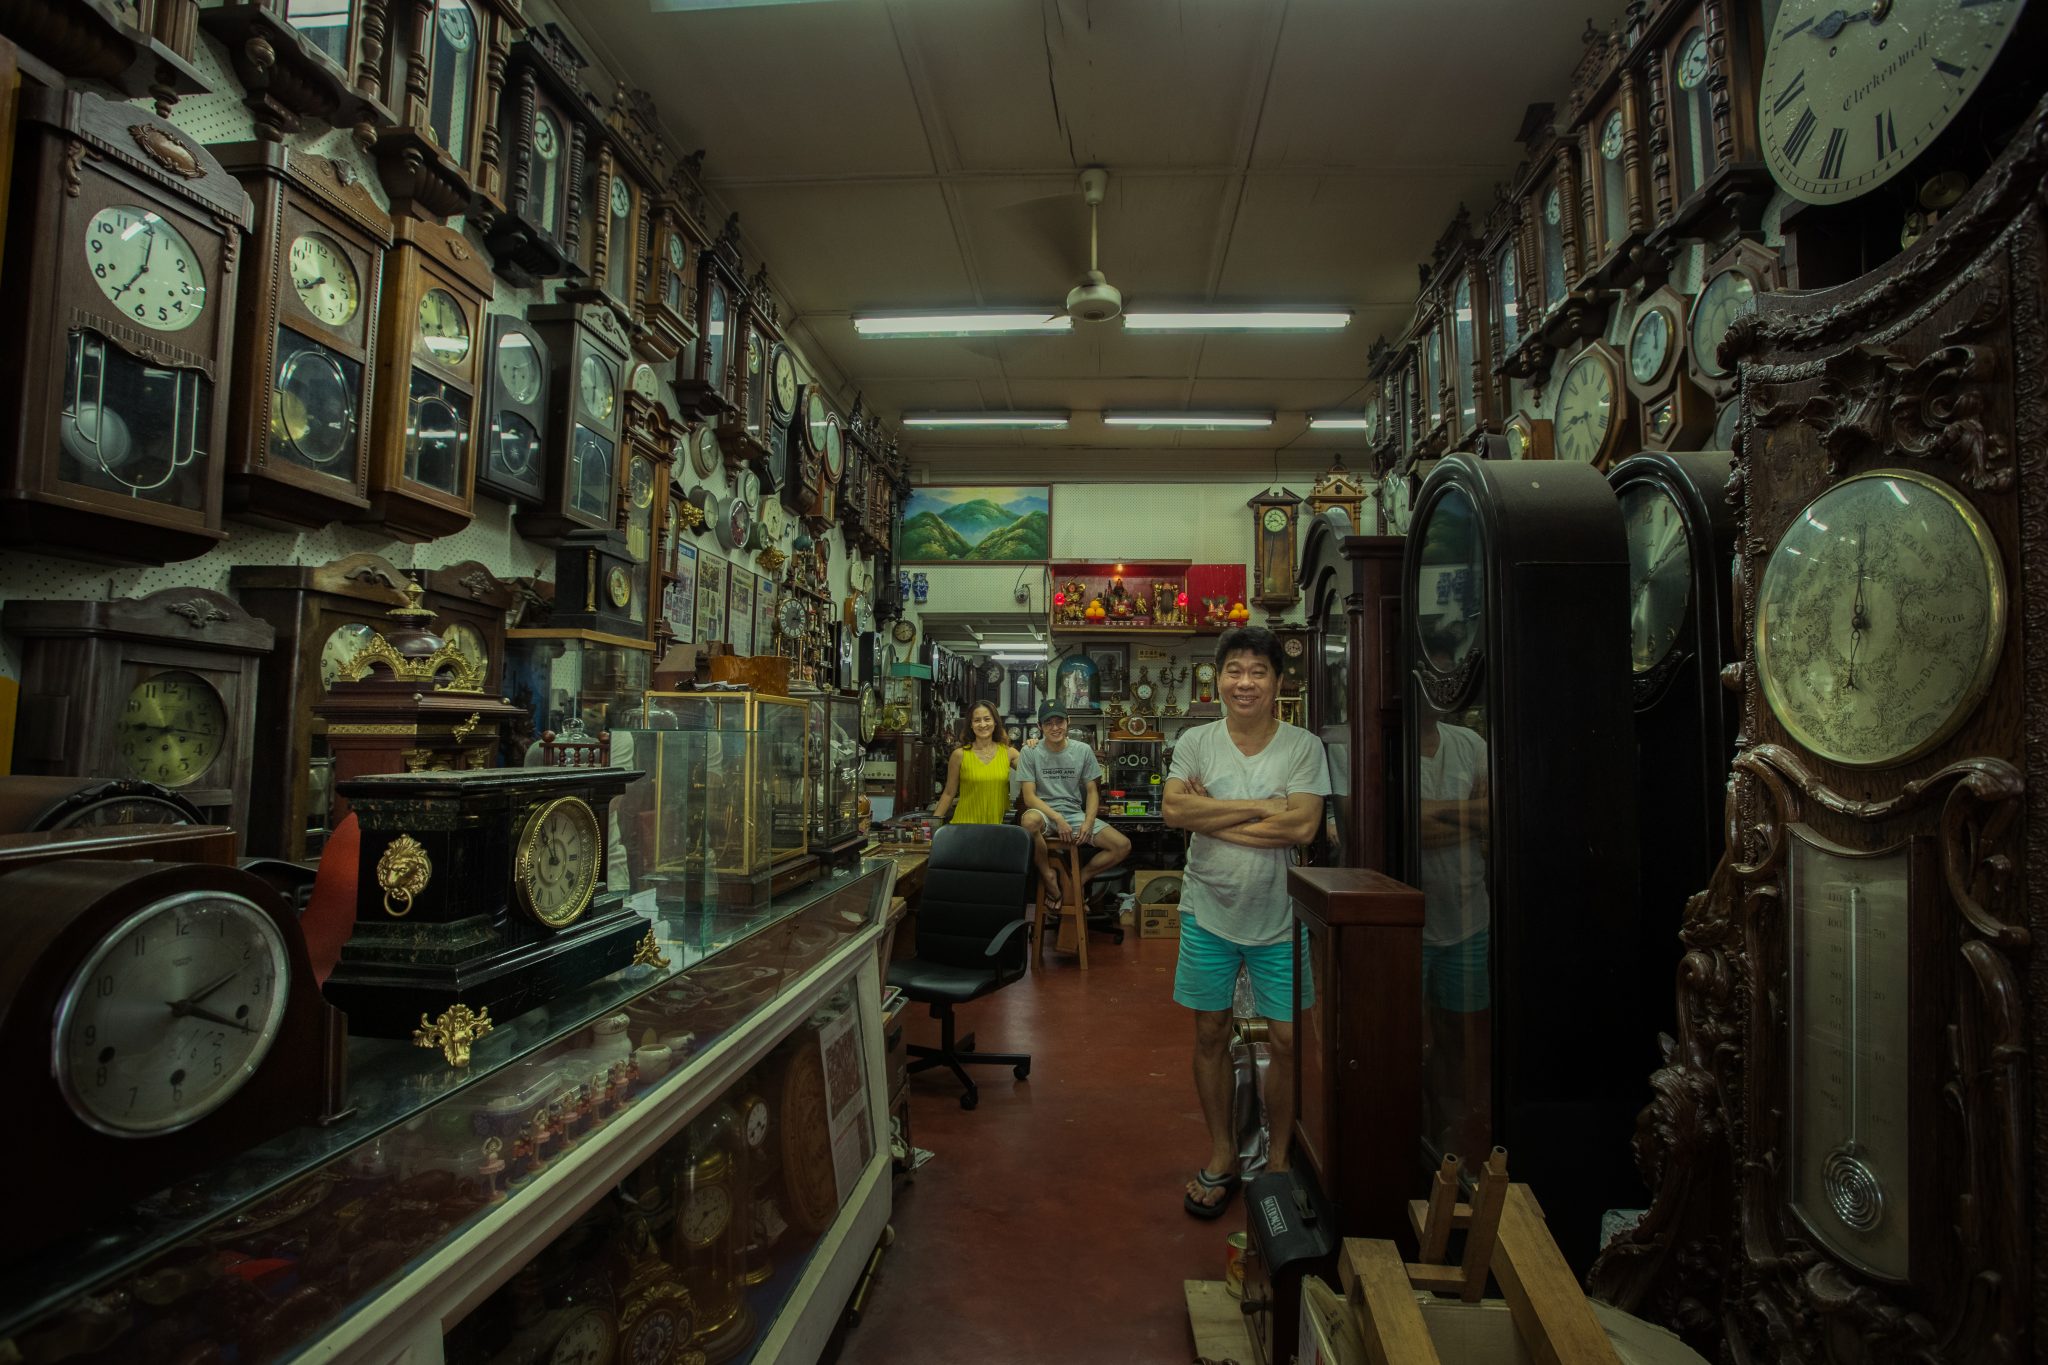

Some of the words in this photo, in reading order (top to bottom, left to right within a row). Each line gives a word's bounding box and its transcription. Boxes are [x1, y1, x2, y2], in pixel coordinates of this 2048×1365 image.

[1842, 30, 1928, 112] Clerkenwell
[98, 220, 114, 235] 10
[91, 239, 103, 254] 9
[165, 239, 169, 251] 1
[317, 244, 328, 259] 12
[95, 263, 107, 279] 8
[176, 258, 187, 274] 2
[111, 285, 122, 301] 7
[181, 281, 191, 296] 3
[135, 303, 146, 318] 6
[158, 306, 169, 322] 5
[172, 300, 183, 313] 4
[146, 684, 156, 699] 11
[163, 680, 178, 694] 12
[193, 743, 203, 756] 4
[158, 764, 169, 777] 6
[178, 758, 189, 771] 5
[175, 918, 190, 936] 12
[220, 918, 225, 937] 1
[135, 936, 146, 956] 11
[97, 975, 114, 999] 10
[252, 977, 261, 996] 3
[84, 1024, 96, 1047] 9
[213, 1055, 223, 1076] 5
[95, 1066, 108, 1088] 8
[128, 1086, 139, 1108] 7
